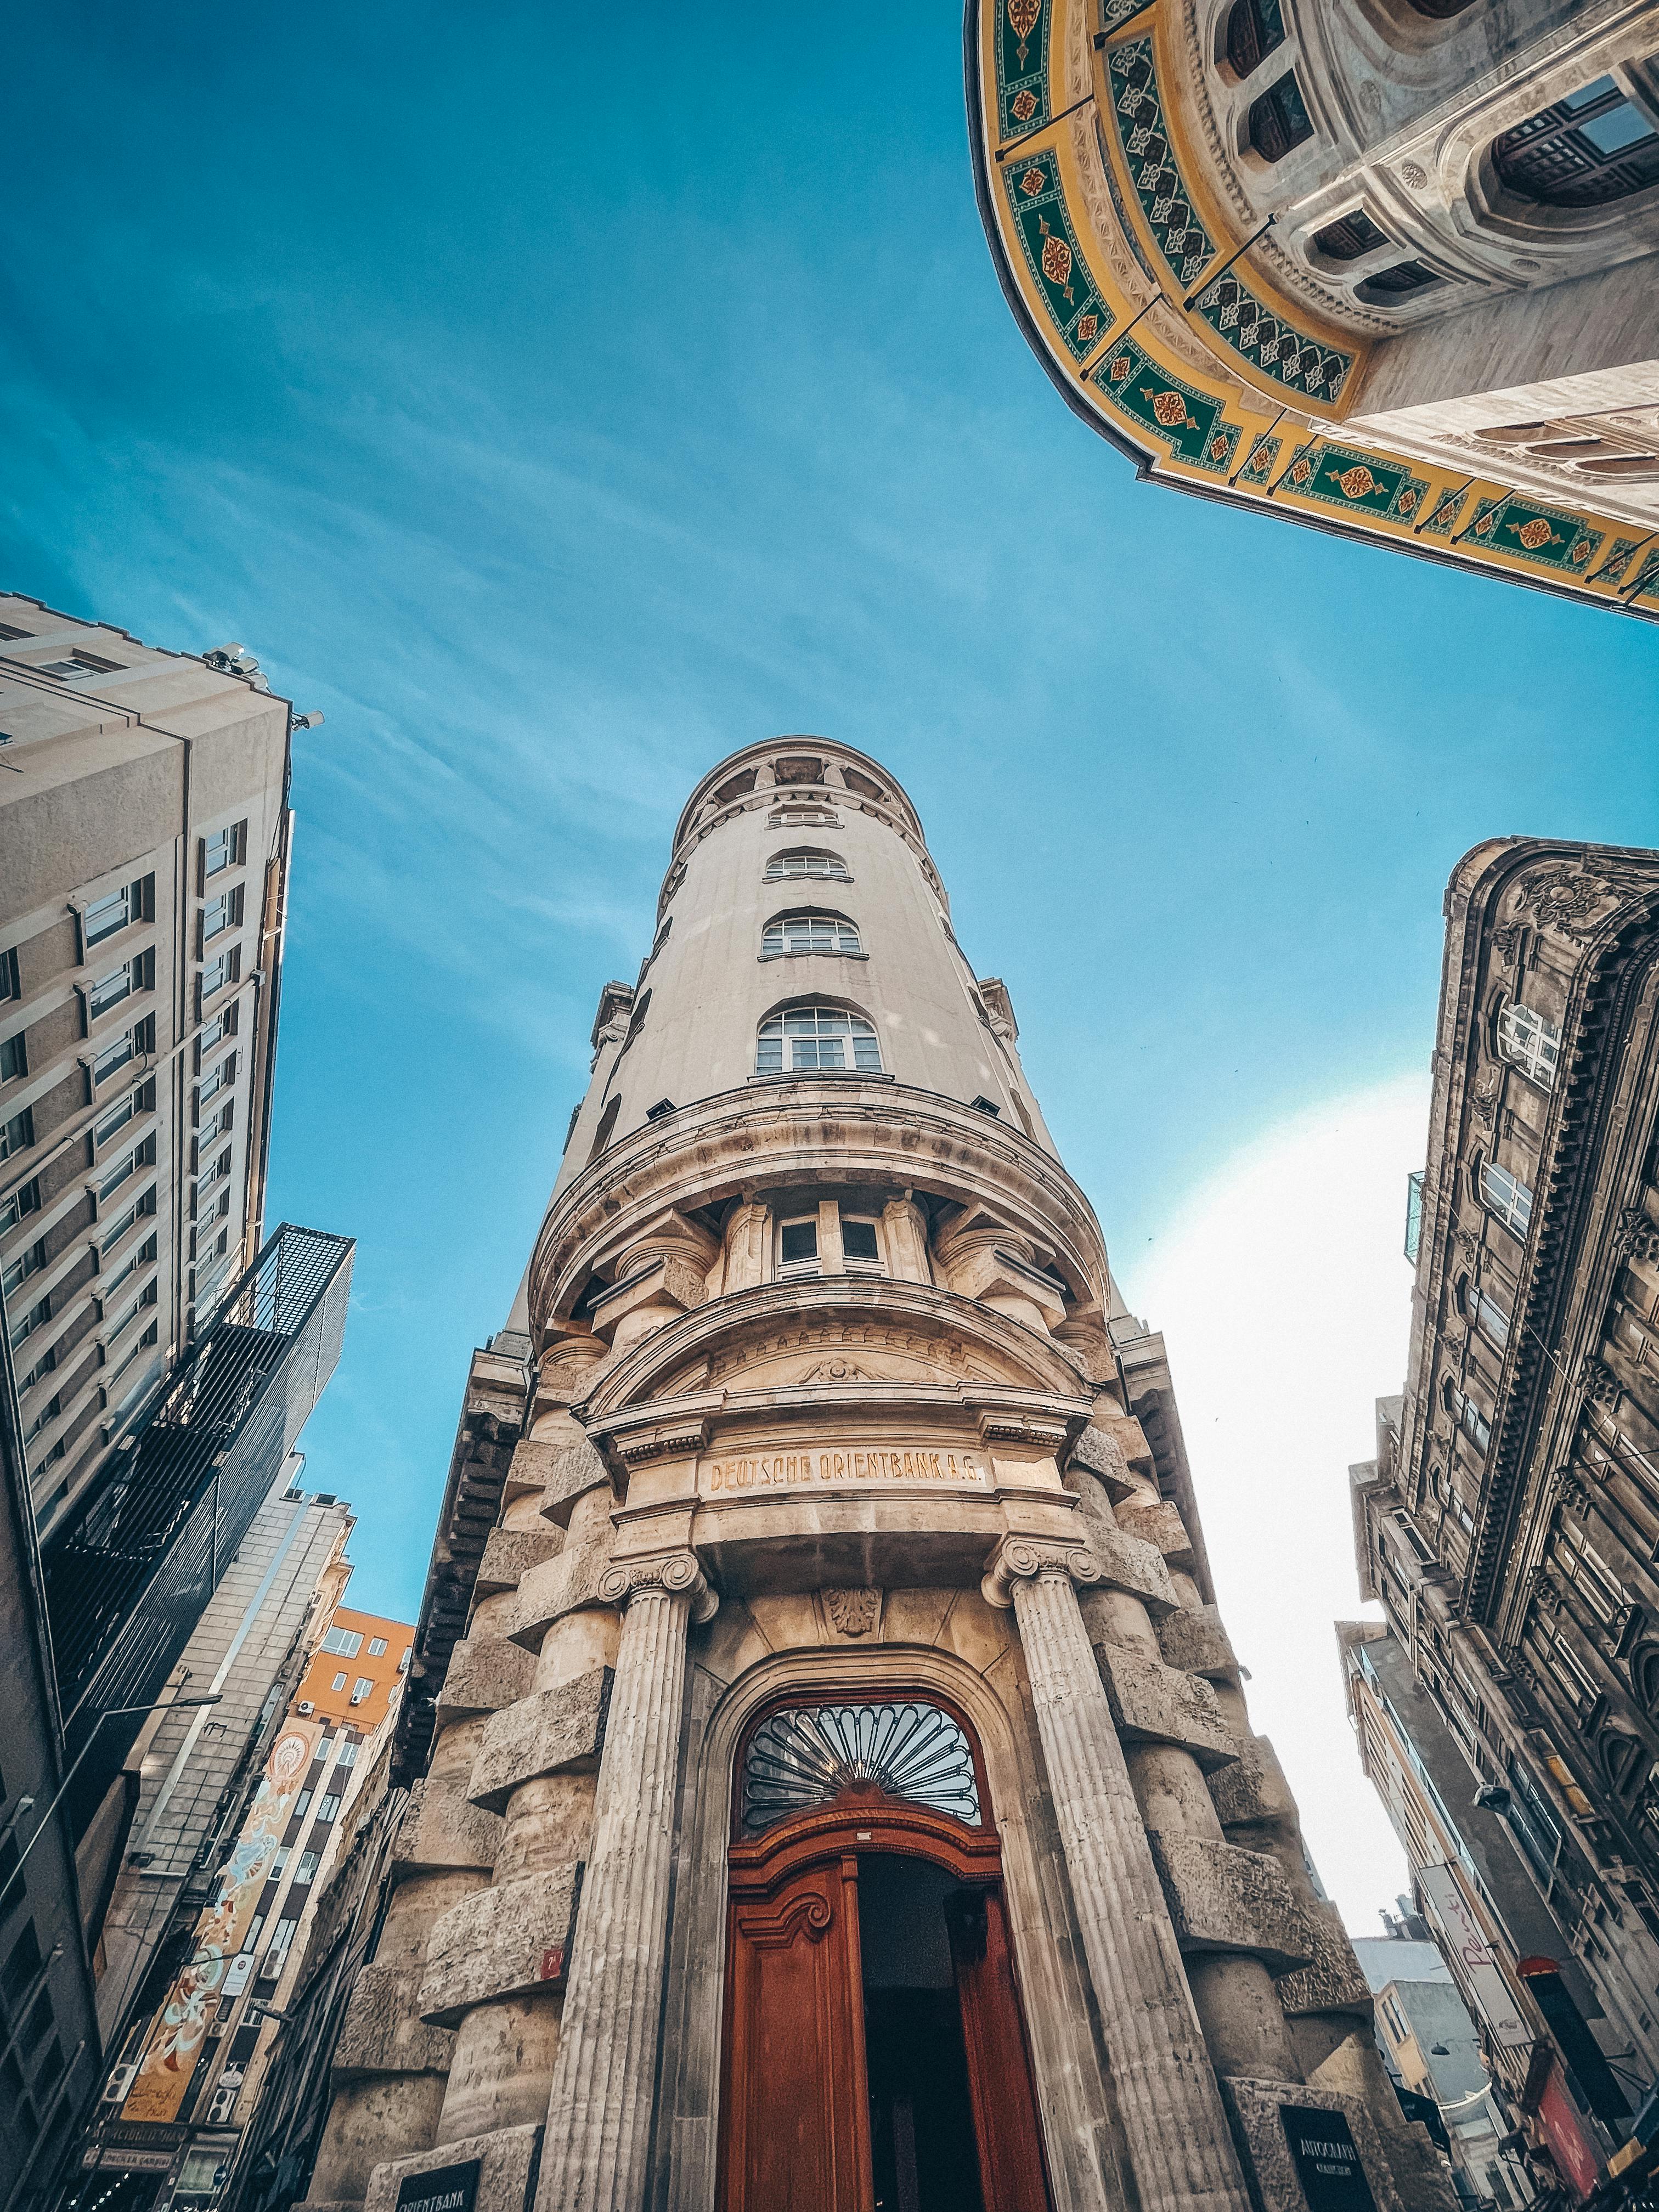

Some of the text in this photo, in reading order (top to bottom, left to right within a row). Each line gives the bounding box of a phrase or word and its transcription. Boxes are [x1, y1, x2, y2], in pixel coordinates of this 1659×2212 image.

[711, 1452, 981, 1491] DEUTSCHE ORIENTBANK A.G.
